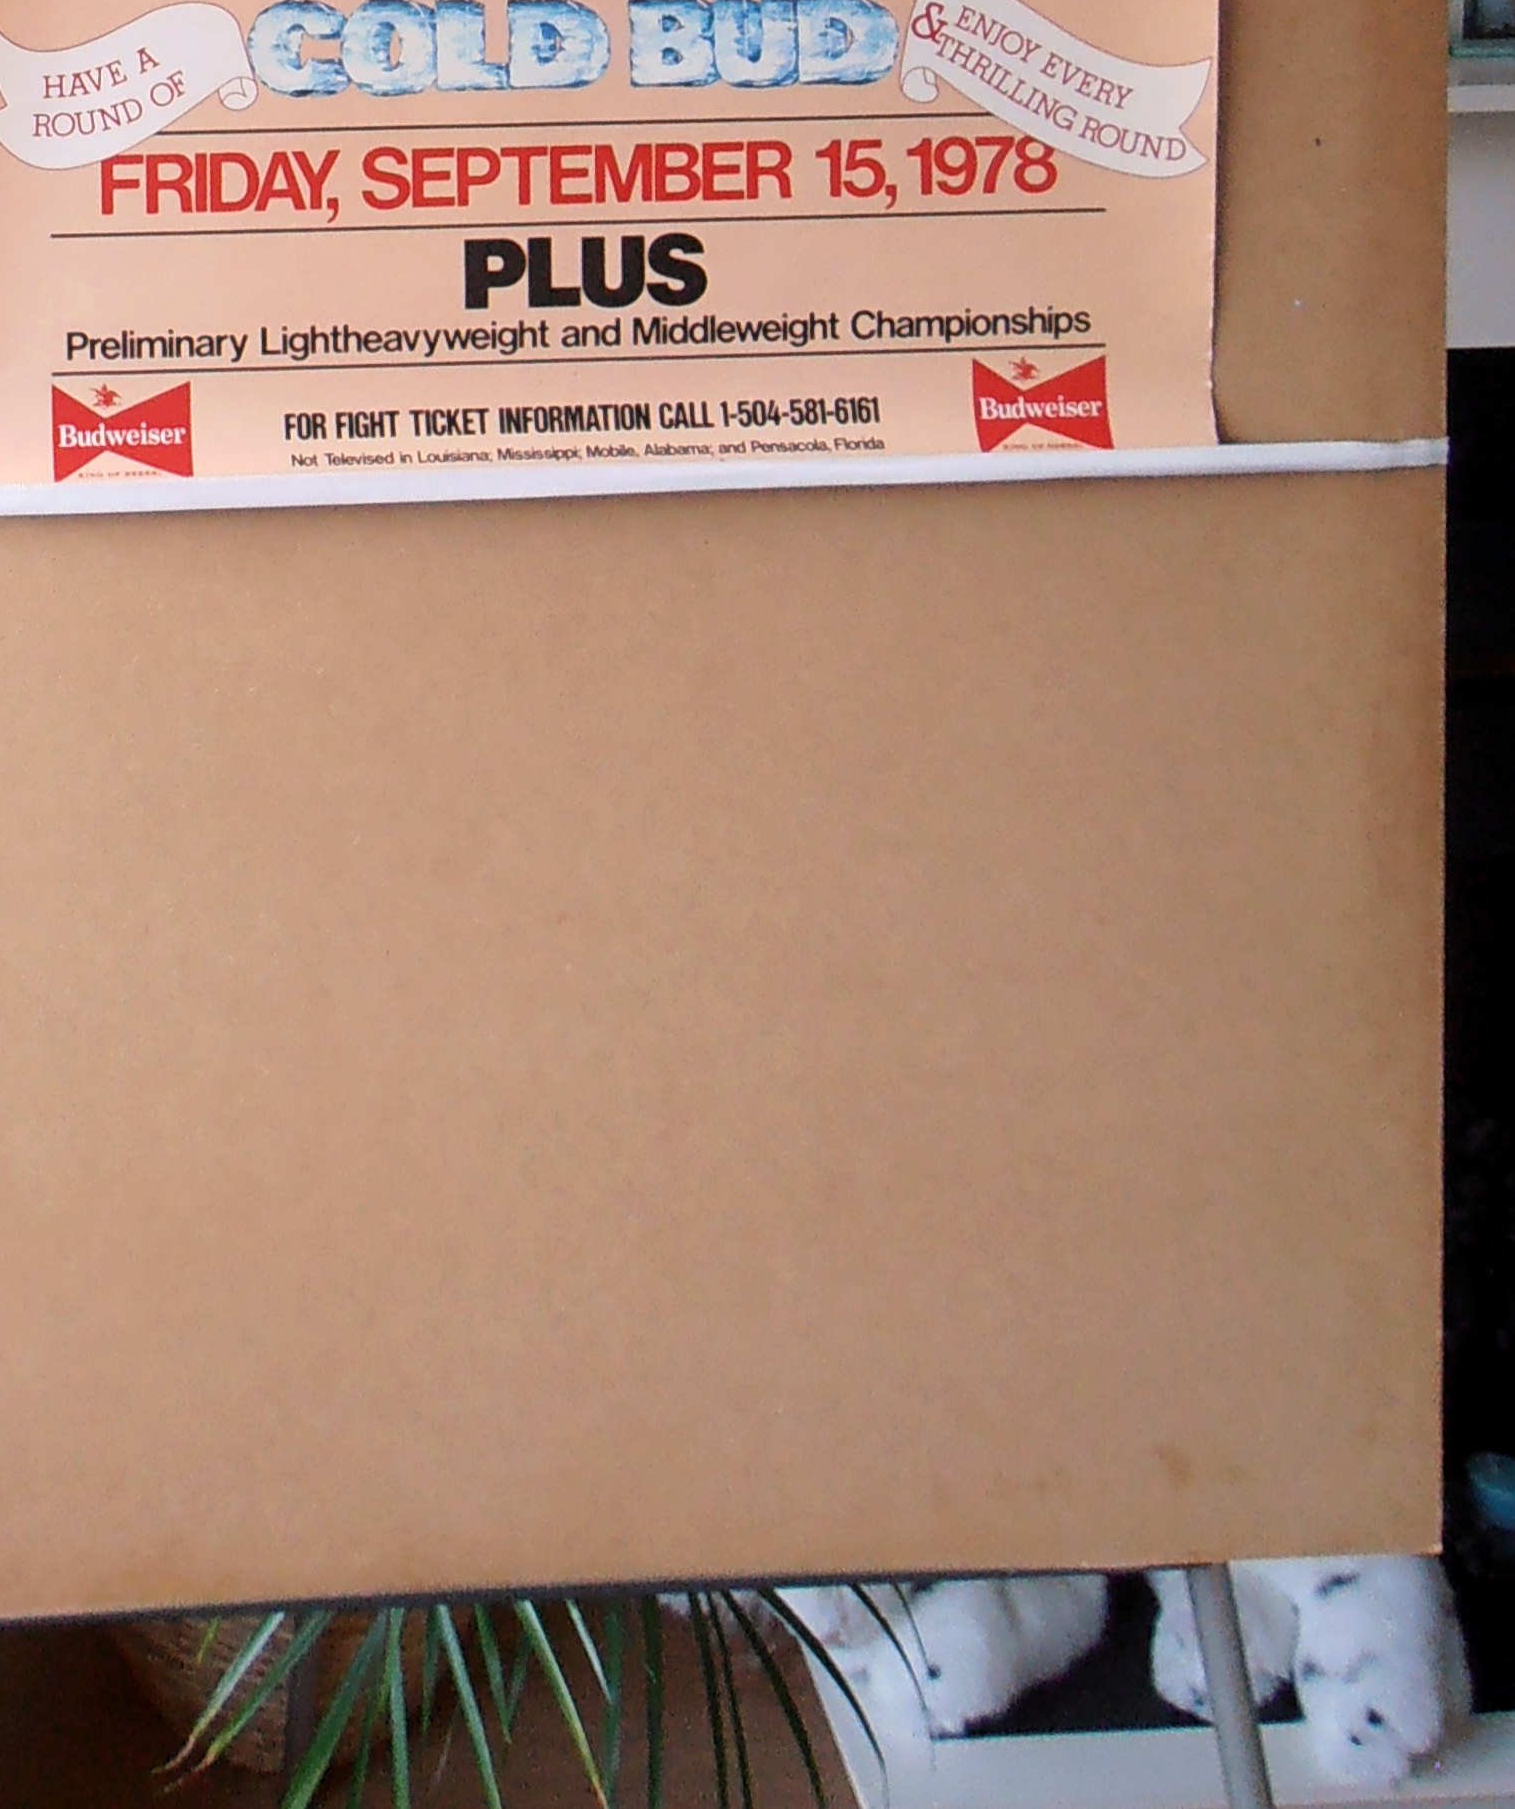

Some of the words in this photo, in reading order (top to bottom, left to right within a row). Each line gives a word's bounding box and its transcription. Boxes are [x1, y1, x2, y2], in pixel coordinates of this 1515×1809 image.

[910, 1, 945, 47] &
[42, 58, 128, 99] HAVE
[136, 46, 161, 73] A
[955, 4, 1042, 65] ENJOY
[1041, 51, 1134, 110] EVERY
[32, 100, 144, 138] ROUND
[149, 70, 188, 109] OF
[934, 31, 1076, 130] THRILLING
[1078, 113, 1187, 163] ROUND
[99, 148, 342, 224] FRIDAY,
[361, 139, 793, 211] SEPTEMBER
[463, 232, 708, 310] PLUS
[66, 328, 249, 363] Preliminary
[259, 320, 550, 362] Lightheavyweight
[560, 317, 621, 349] and
[632, 310, 840, 348] Middleweight
[850, 304, 1092, 342] Championships
[57, 421, 187, 449] Budweiser
[284, 412, 327, 441] FOR
[335, 410, 400, 439] FIGHT
[409, 407, 489, 437] TICKET
[498, 402, 651, 435] INFORMATION
[659, 400, 715, 430] CALL
[720, 395, 881, 428] 1-504-581-6161
[979, 394, 1103, 420] Budweiser
[291, 453, 318, 468] Not
[324, 451, 395, 467] Televised
[400, 451, 412, 465] in
[718, 440, 746, 455] and
[834, 436, 885, 451] Florida
